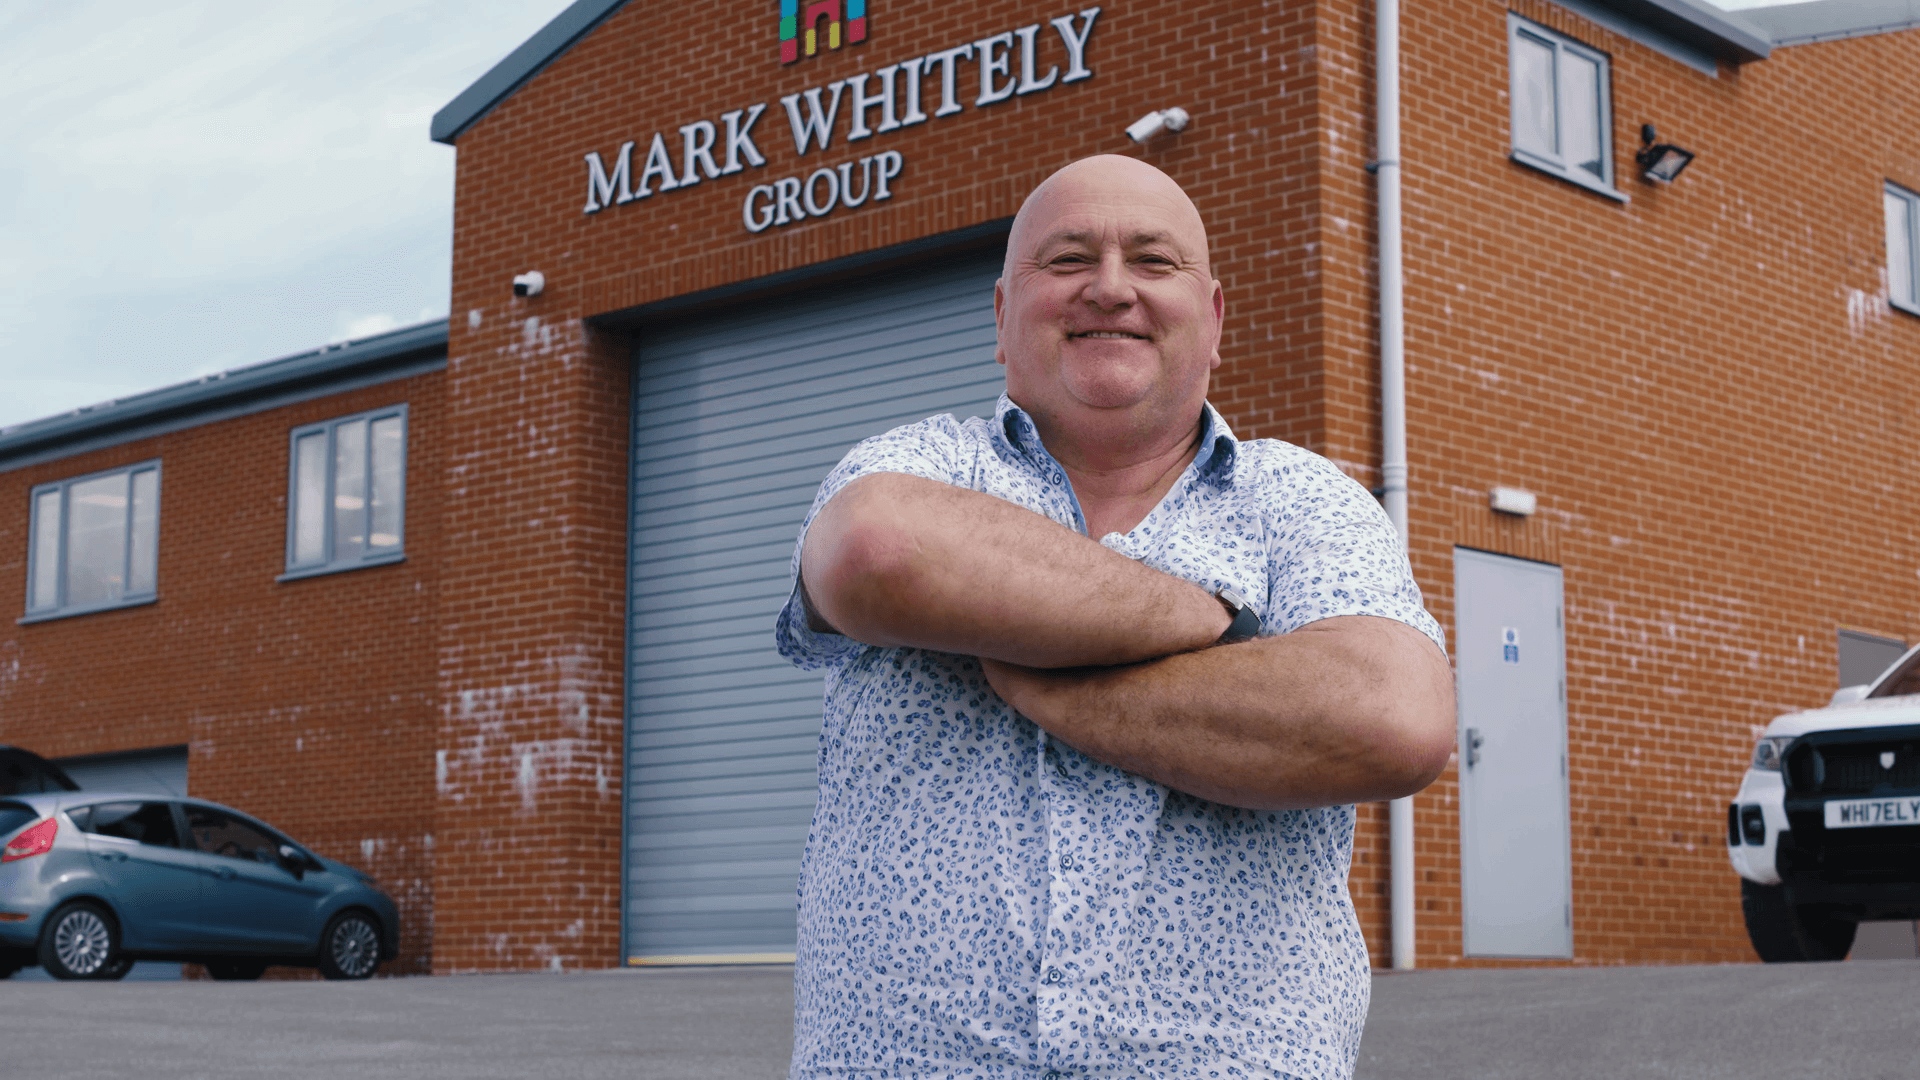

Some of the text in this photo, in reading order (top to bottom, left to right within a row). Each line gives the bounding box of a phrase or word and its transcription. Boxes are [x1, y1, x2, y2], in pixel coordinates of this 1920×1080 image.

[583, 6, 1101, 214] MARK WHITELY
[742, 149, 903, 233] GROUP
